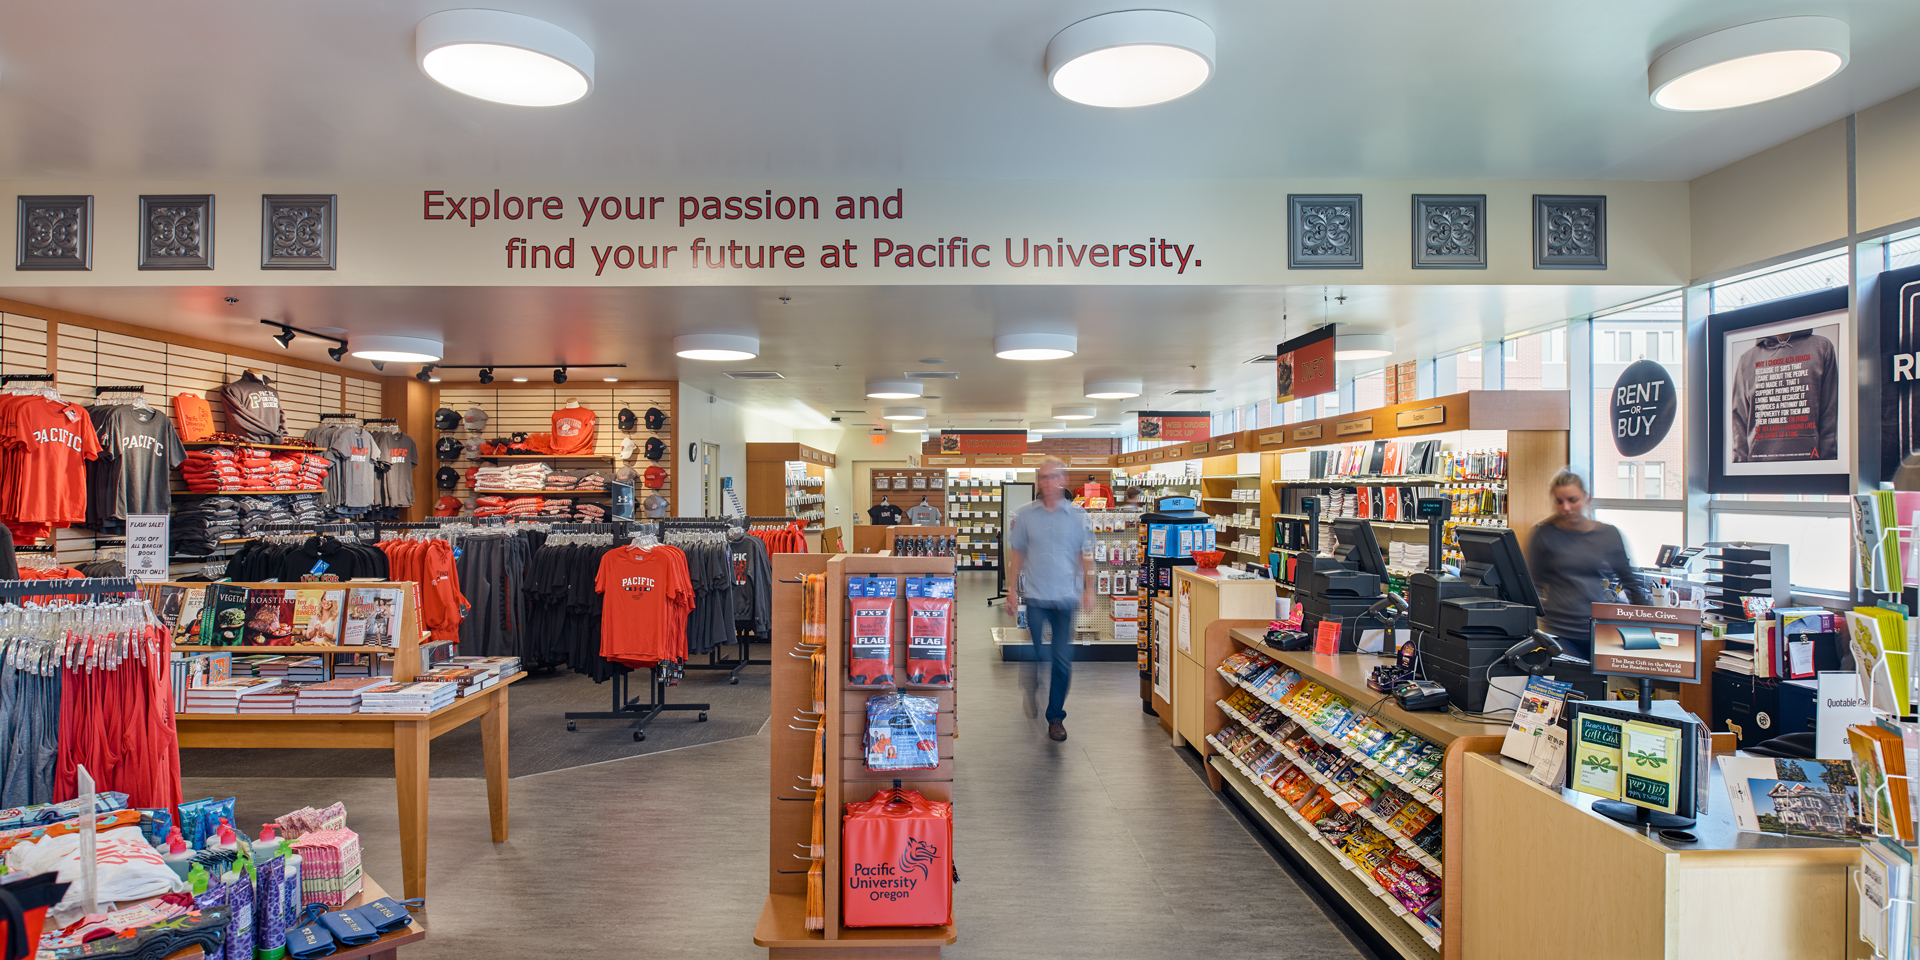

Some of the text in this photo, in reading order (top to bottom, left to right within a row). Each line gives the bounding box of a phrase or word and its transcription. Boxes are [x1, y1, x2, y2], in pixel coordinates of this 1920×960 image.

[423, 189, 903, 227] Explore your passion and
[505, 237, 1202, 276] find your future at Pacific University.
[1768, 358, 1784, 366] CHOOSE
[1301, 357, 1326, 382] INFO
[1755, 366, 1774, 375] BECAUSE
[1780, 364, 1791, 372] SAYS
[1769, 373, 1783, 381] ABOUT
[1793, 369, 1809, 378] PEOPLE
[1786, 378, 1796, 386] THAT
[1616, 380, 1665, 406] RENT
[1755, 389, 1774, 397] SUPPORT
[1790, 385, 1805, 393] PEOPLE
[1755, 396, 1768, 404] LIVING
[1782, 393, 1800, 401] BECAUSE
[1631, 406, 1641, 414] OR
[1755, 403, 1775, 411] PROVIDES
[1780, 401, 1798, 409] PATHWAY
[1761, 410, 1780, 418] POVERTY
[1165, 421, 1208, 429] WEB ORDER
[1618, 415, 1657, 438] BUY
[33, 427, 82, 452] PACIFIC
[872, 435, 884, 444] EXIT
[966, 439, 1021, 448] TEXTBOOKS
[622, 577, 655, 587] PACIFIC
[350, 596, 364, 606] CAN
[357, 602, 374, 613] COOK
[1616, 608, 1678, 620] Buy. Use. Give.
[1528, 684, 1547, 695] Software
[1827, 698, 1857, 708] Quotable
[1585, 721, 1602, 729] Barnes
[1606, 724, 1620, 732] Noble
[1584, 729, 1619, 744] Gift Card
[1649, 783, 1666, 796] Gift
[854, 863, 895, 876] Pacific
[850, 876, 917, 890] University
[870, 891, 909, 901] Oregon
